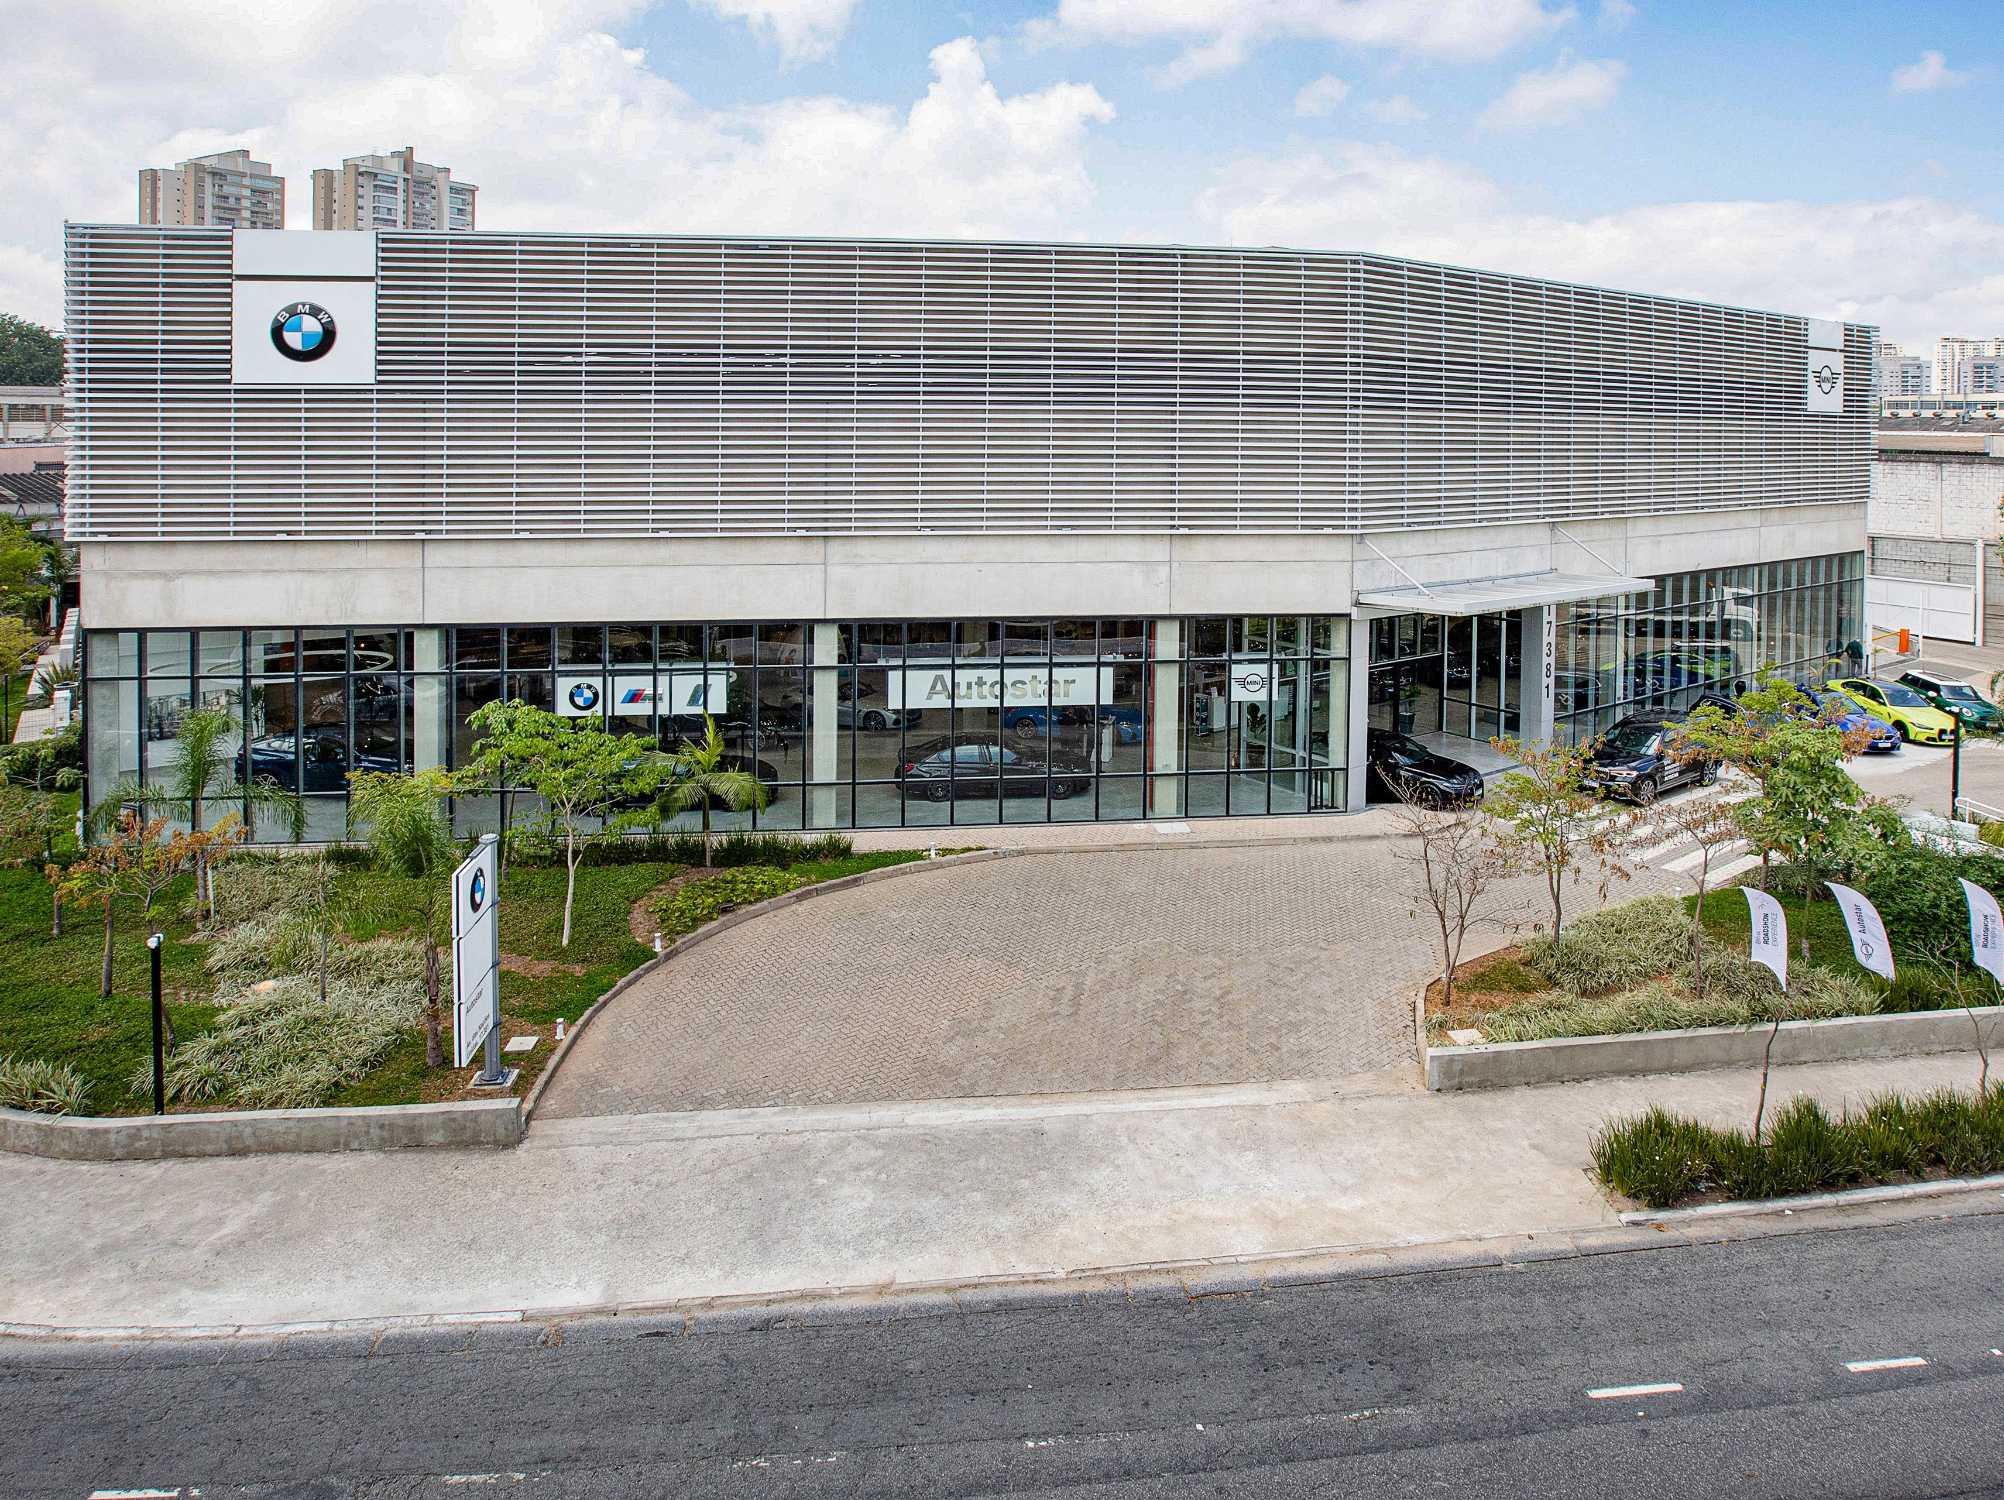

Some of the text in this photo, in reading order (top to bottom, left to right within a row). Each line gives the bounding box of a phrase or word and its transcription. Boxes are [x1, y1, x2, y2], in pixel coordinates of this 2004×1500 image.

[277, 304, 331, 324] BMW
[925, 674, 1076, 700] Autostar
[1854, 904, 1866, 934] Autostar
